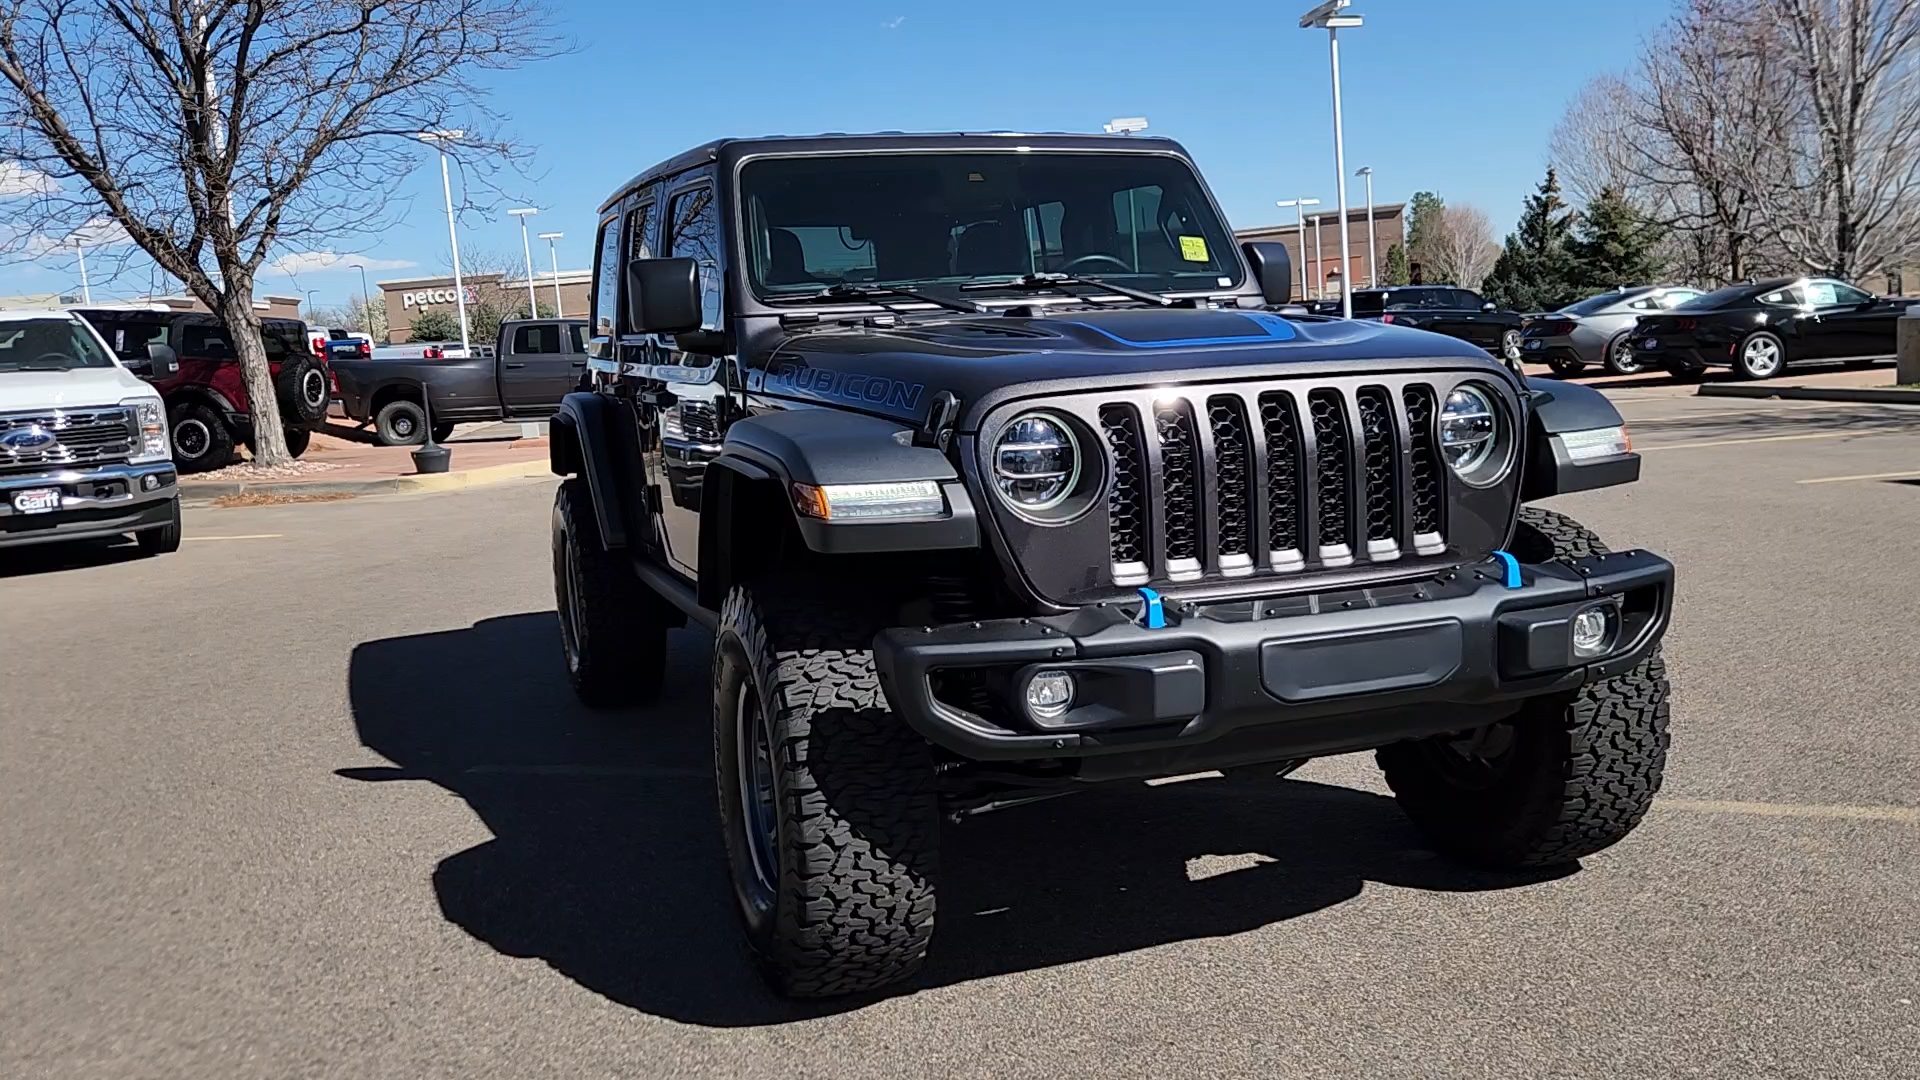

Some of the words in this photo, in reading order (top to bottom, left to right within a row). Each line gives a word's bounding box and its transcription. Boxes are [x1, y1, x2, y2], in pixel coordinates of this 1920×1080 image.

[403, 288, 457, 309] petco
[775, 363, 924, 411] RUBICON
[15, 491, 59, 511] Garff
